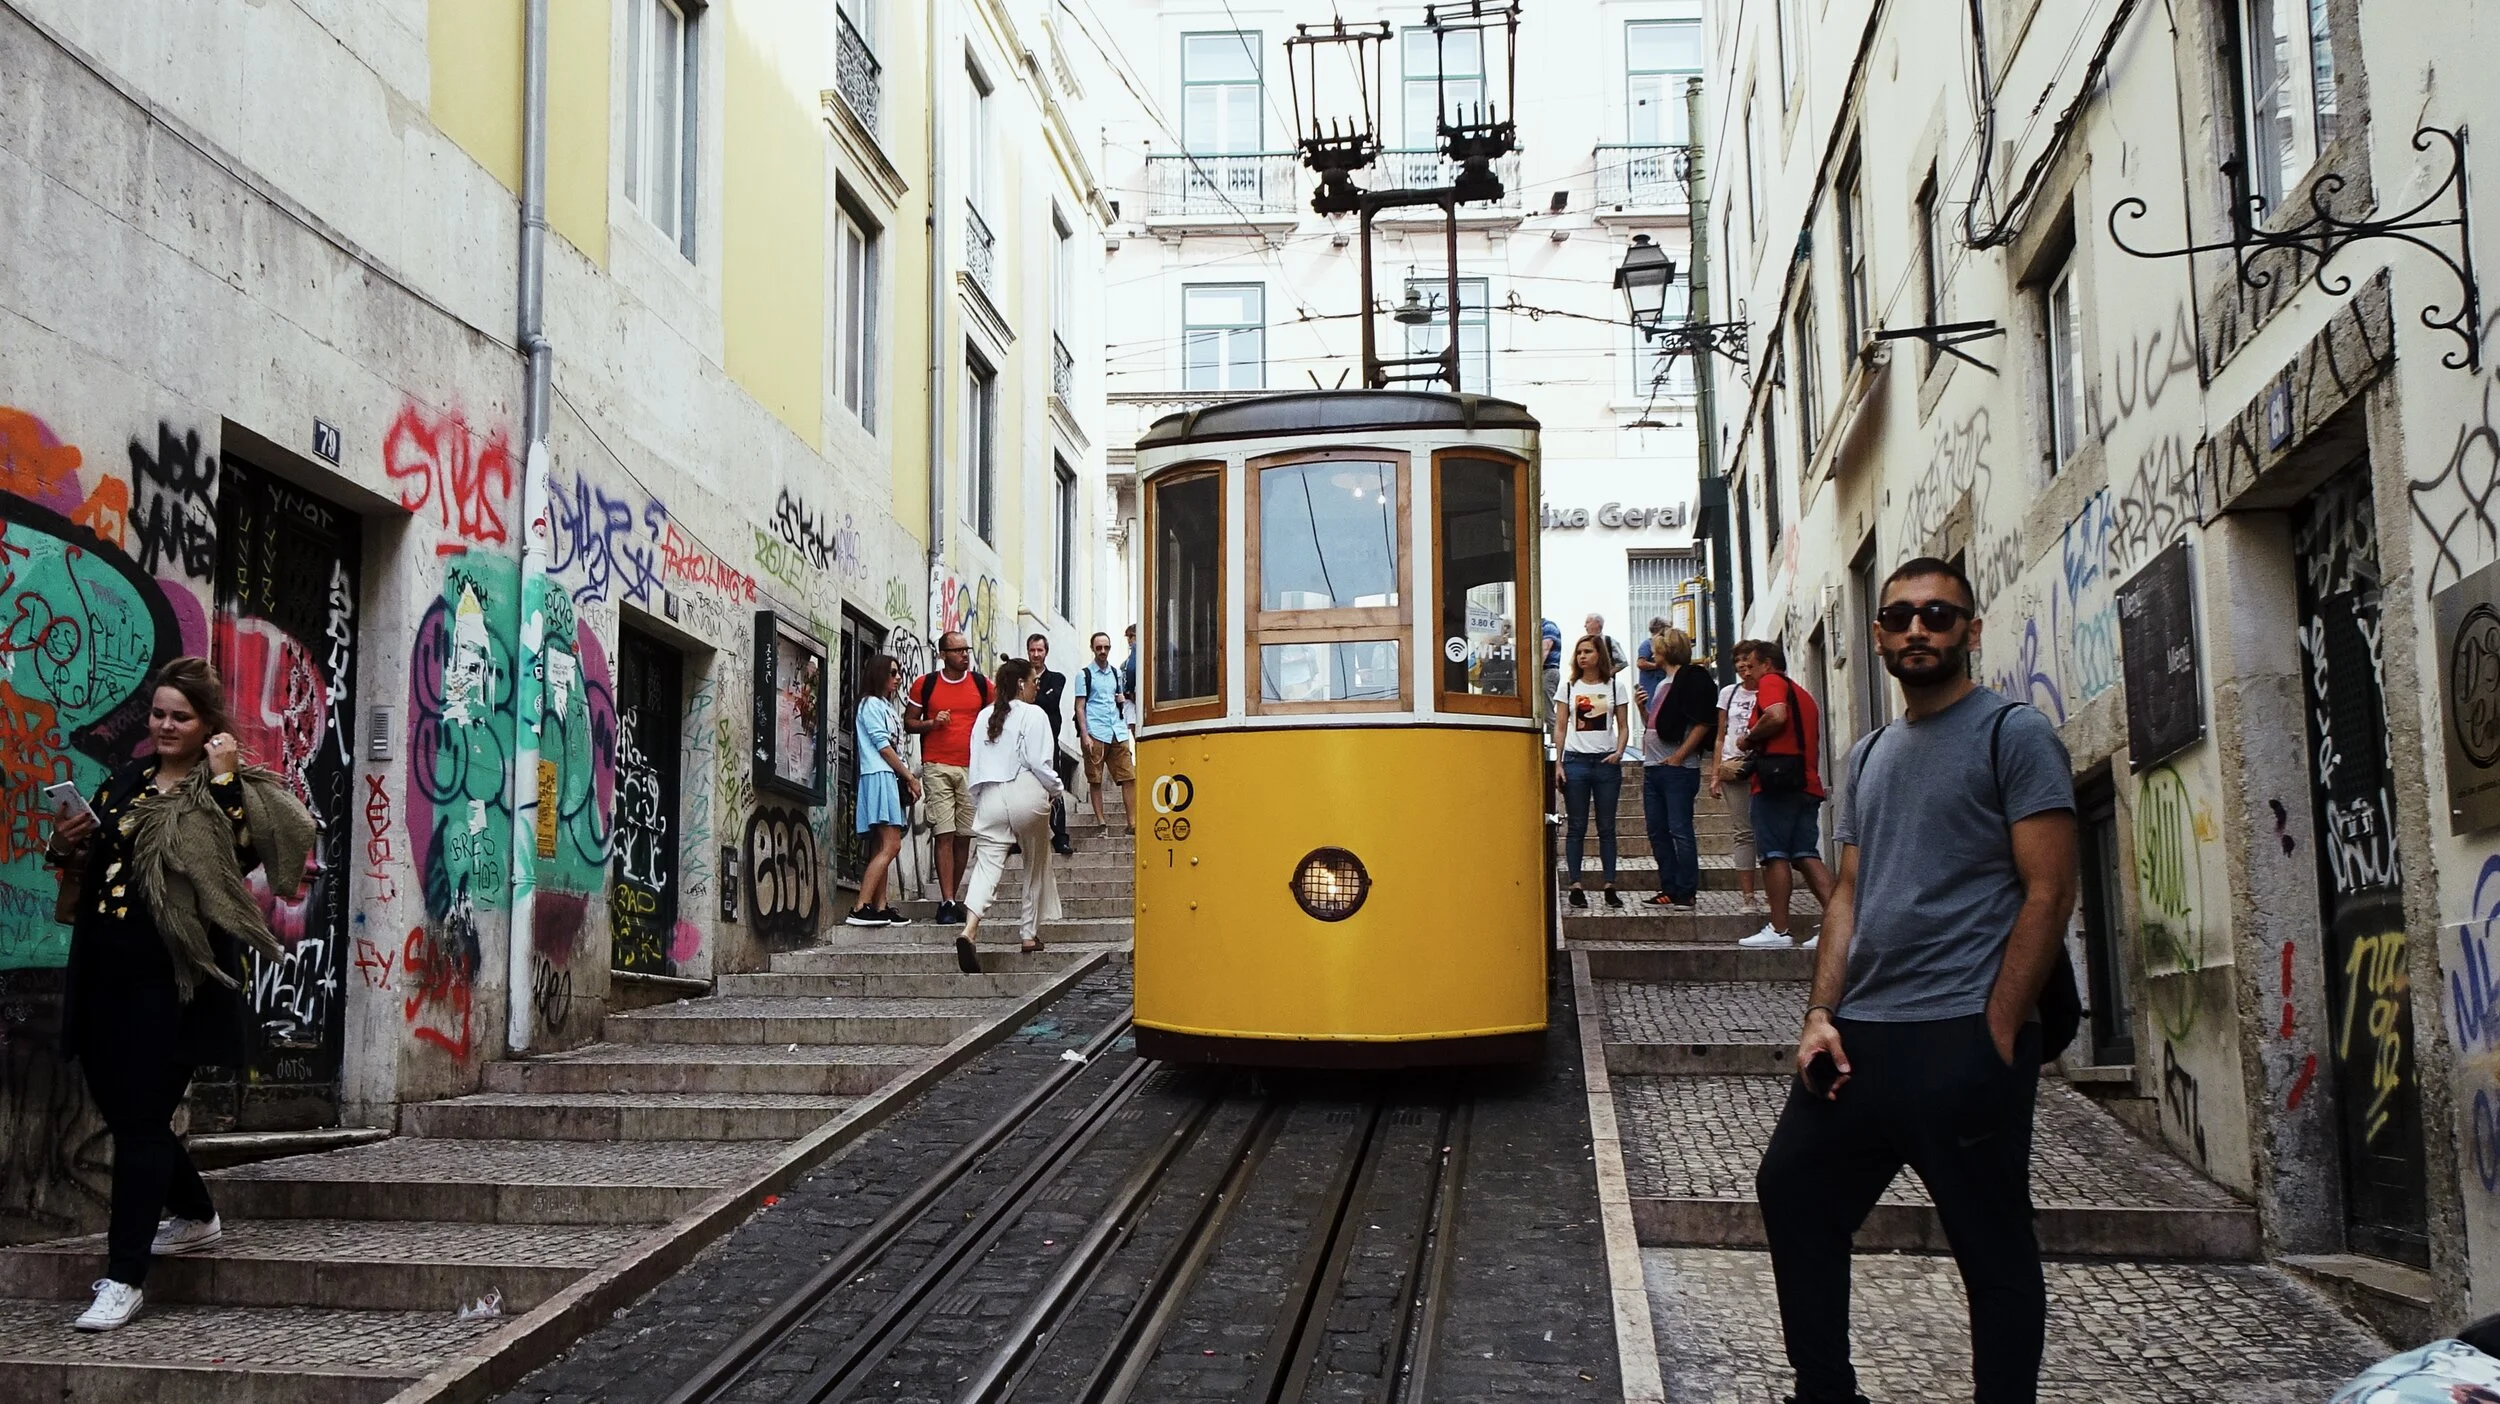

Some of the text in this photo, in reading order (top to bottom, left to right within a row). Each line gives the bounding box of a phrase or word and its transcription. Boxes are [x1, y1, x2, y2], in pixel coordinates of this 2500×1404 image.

[319, 423, 337, 458] 79
[1540, 501, 1686, 530] ixa Geral
[1471, 618, 1495, 629] 3.80 €
[452, 828, 495, 861] BRES
[1168, 848, 1173, 868] 1
